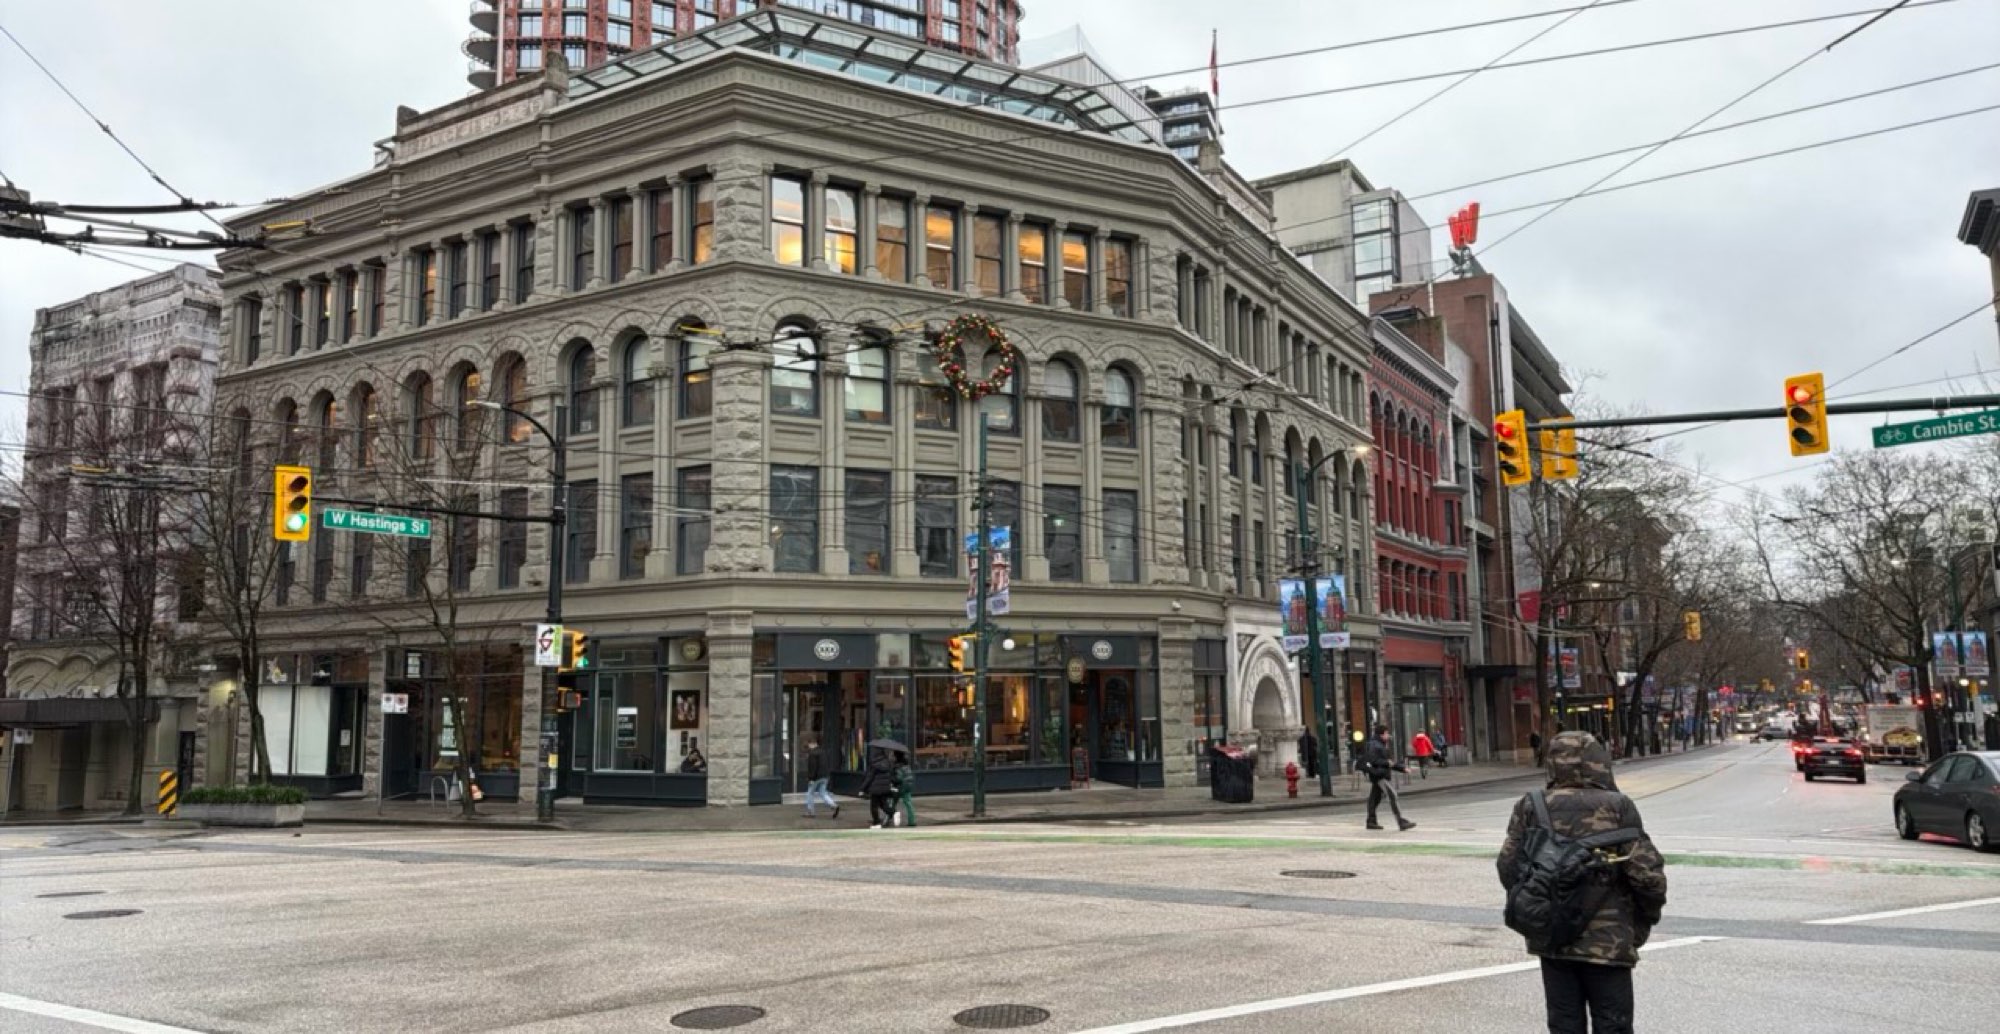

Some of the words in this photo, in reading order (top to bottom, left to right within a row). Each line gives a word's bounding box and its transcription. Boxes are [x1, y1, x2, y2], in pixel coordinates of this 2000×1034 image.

[1912, 420, 1975, 440] Cambie
[331, 511, 345, 525] W
[350, 515, 406, 533] Hastings
[411, 520, 425, 534] St
